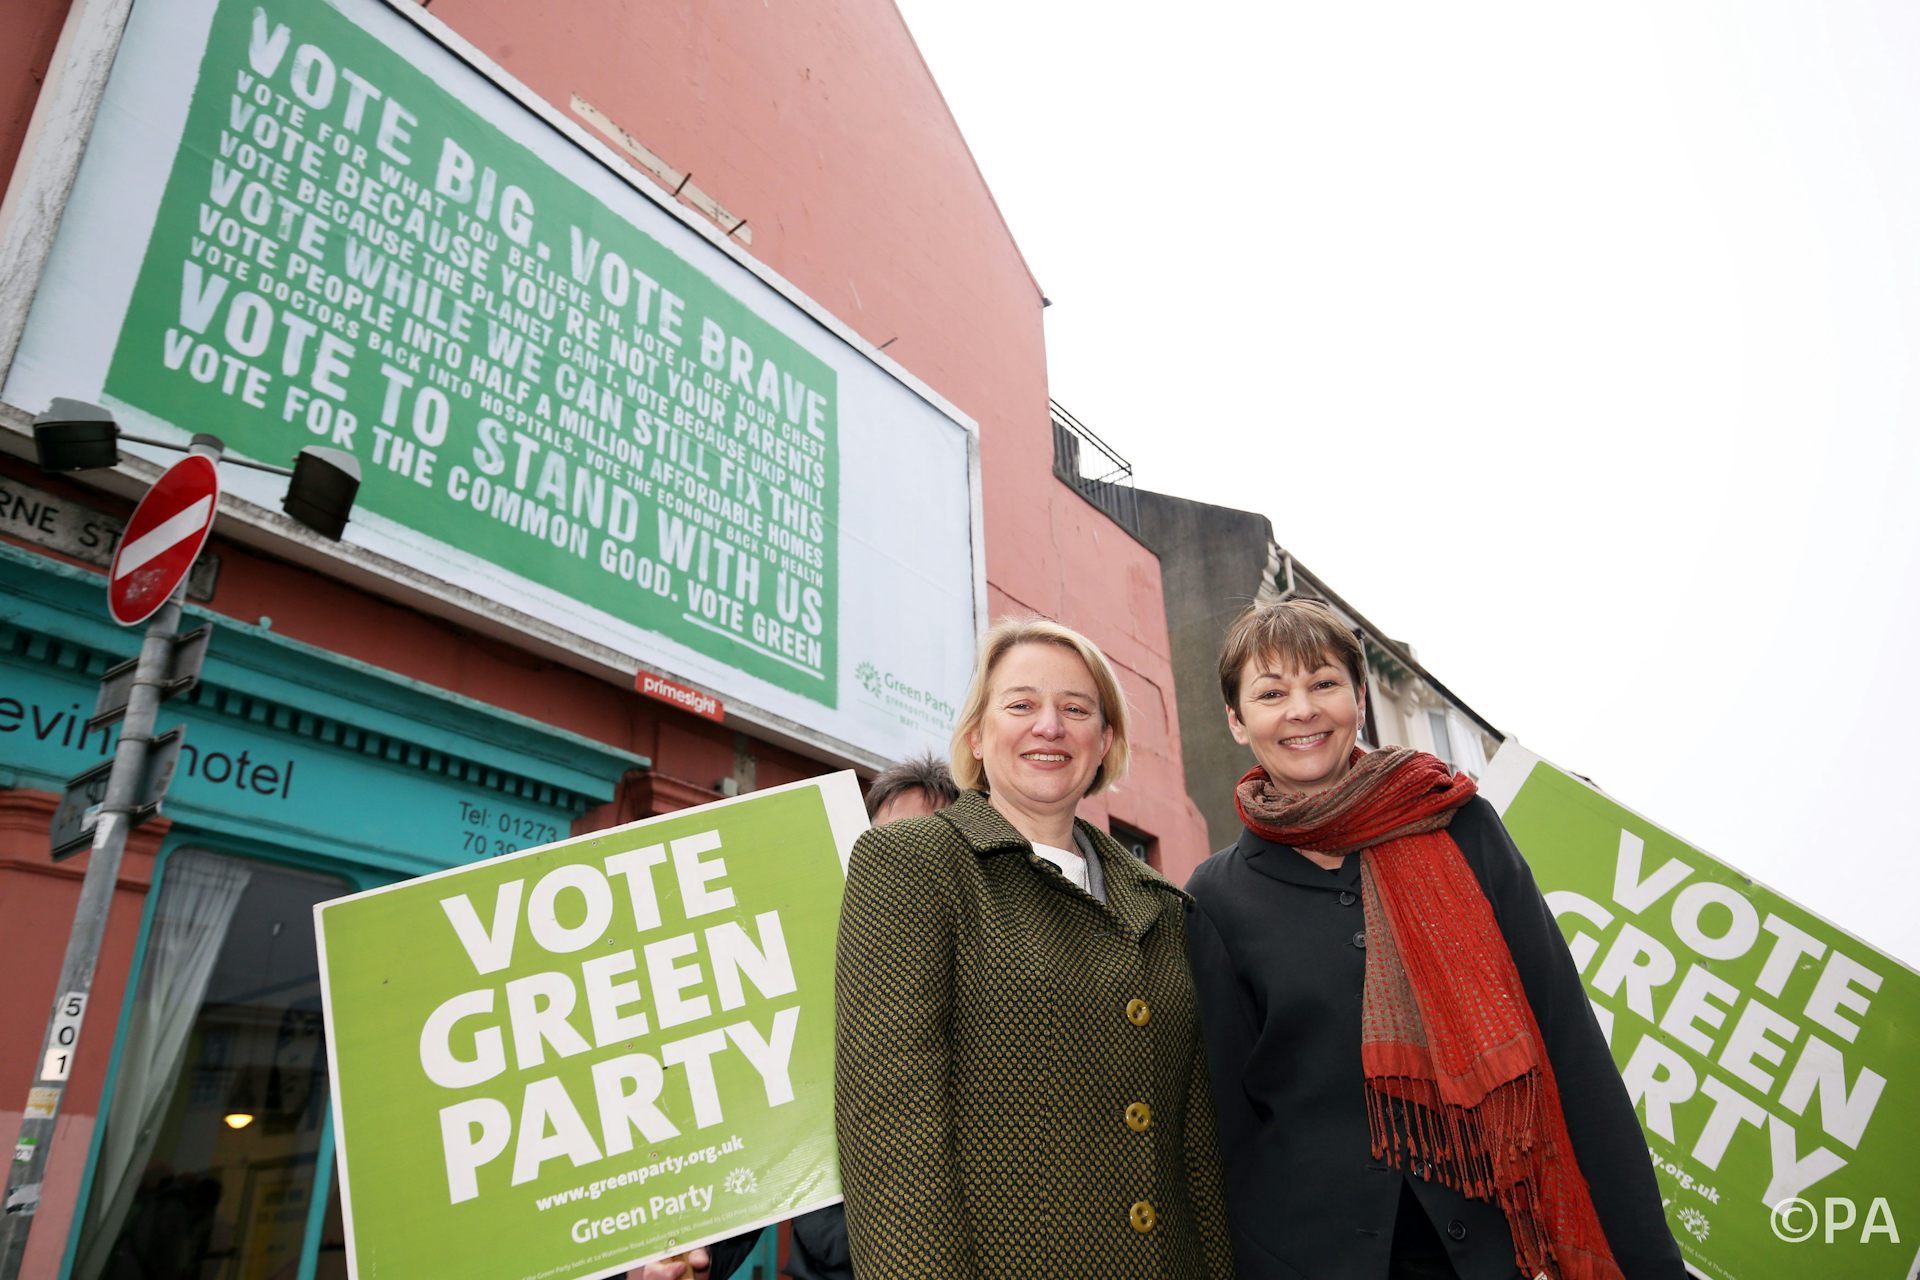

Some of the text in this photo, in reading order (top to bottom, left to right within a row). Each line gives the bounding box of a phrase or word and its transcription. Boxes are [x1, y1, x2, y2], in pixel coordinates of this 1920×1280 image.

[220, 130, 823, 510] VOTE BECAUSE THE PLANET CAN'T. VOTE BECAUSE UKIP WILL
[231, 95, 825, 488] VOTE BECAUSE YOU'RE NOT YOUR PARENTS
[237, 70, 825, 461] VOTE FOR WHAT YOU BELIEVE IN. VOTE IT OFF YOUR CHEST
[249, 6, 826, 440] VOTE BIG. VOTE BRAVE
[179, 260, 354, 401] VOTE
[380, 363, 450, 448] TO
[473, 418, 638, 542] STAND
[657, 508, 760, 606] WITH
[776, 568, 823, 636] US
[192, 237, 824, 589] VOTE DOCTORS BACK INTO HOSPITALS. VOTE THE ECONOMY BACK TO HEALTH
[199, 203, 823, 569] VOTE PEOPLE INTO HALF A MILLION AFFORDABLE HOMES
[210, 160, 823, 544] VOTE WHILE WE CAN STILL FIX THIS
[163, 328, 272, 409] VOTE
[283, 386, 357, 450] FOR
[372, 426, 437, 487] THE
[447, 466, 588, 558] COMMON
[600, 539, 679, 602] GOOD.
[687, 579, 744, 633] VOTE
[752, 612, 822, 668] GREEN
[643, 677, 716, 714] primesight
[884, 672, 956, 722] Green Party
[439, 829, 736, 976] VOTE
[459, 801, 557, 843] Tel: 01273
[463, 830, 488, 855] 70
[419, 910, 798, 1090] GREEN
[1542, 889, 1888, 1151] GREEN
[1612, 827, 1884, 1044] VOTE
[439, 1005, 801, 1205] PARTY
[536, 1134, 745, 1212] www.greenparty.org.uk
[1592, 1005, 1849, 1219] RTY
[571, 1210, 647, 1245] Green
[649, 1183, 714, 1220] Party
